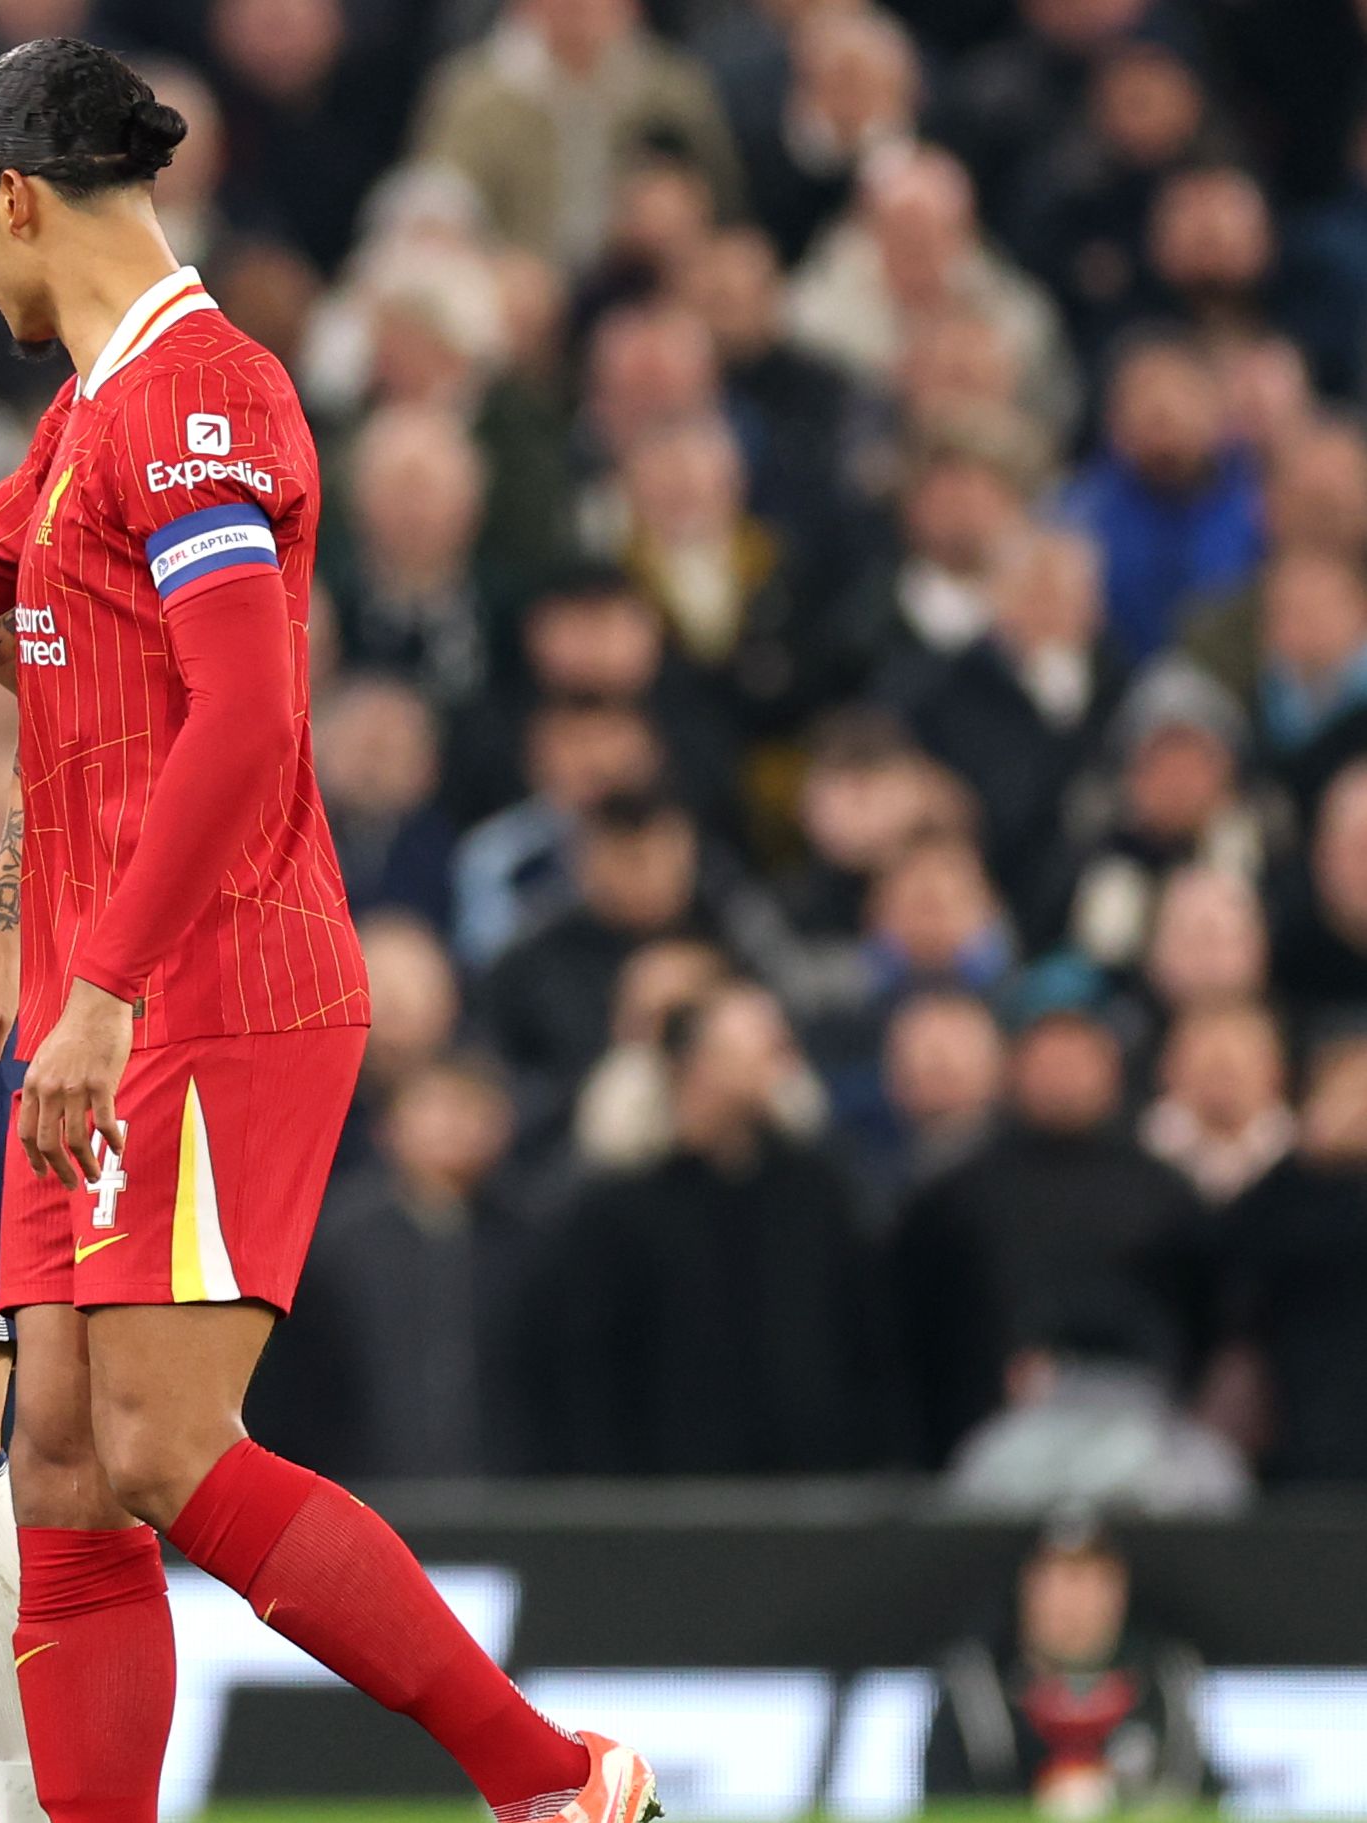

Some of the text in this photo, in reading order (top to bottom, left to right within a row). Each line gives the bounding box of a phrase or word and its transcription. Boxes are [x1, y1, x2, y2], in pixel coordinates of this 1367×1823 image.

[146, 459, 273, 494] Expedia
[169, 531, 249, 567] EFL CAPTAIN
[85, 1119, 129, 1229] 4
